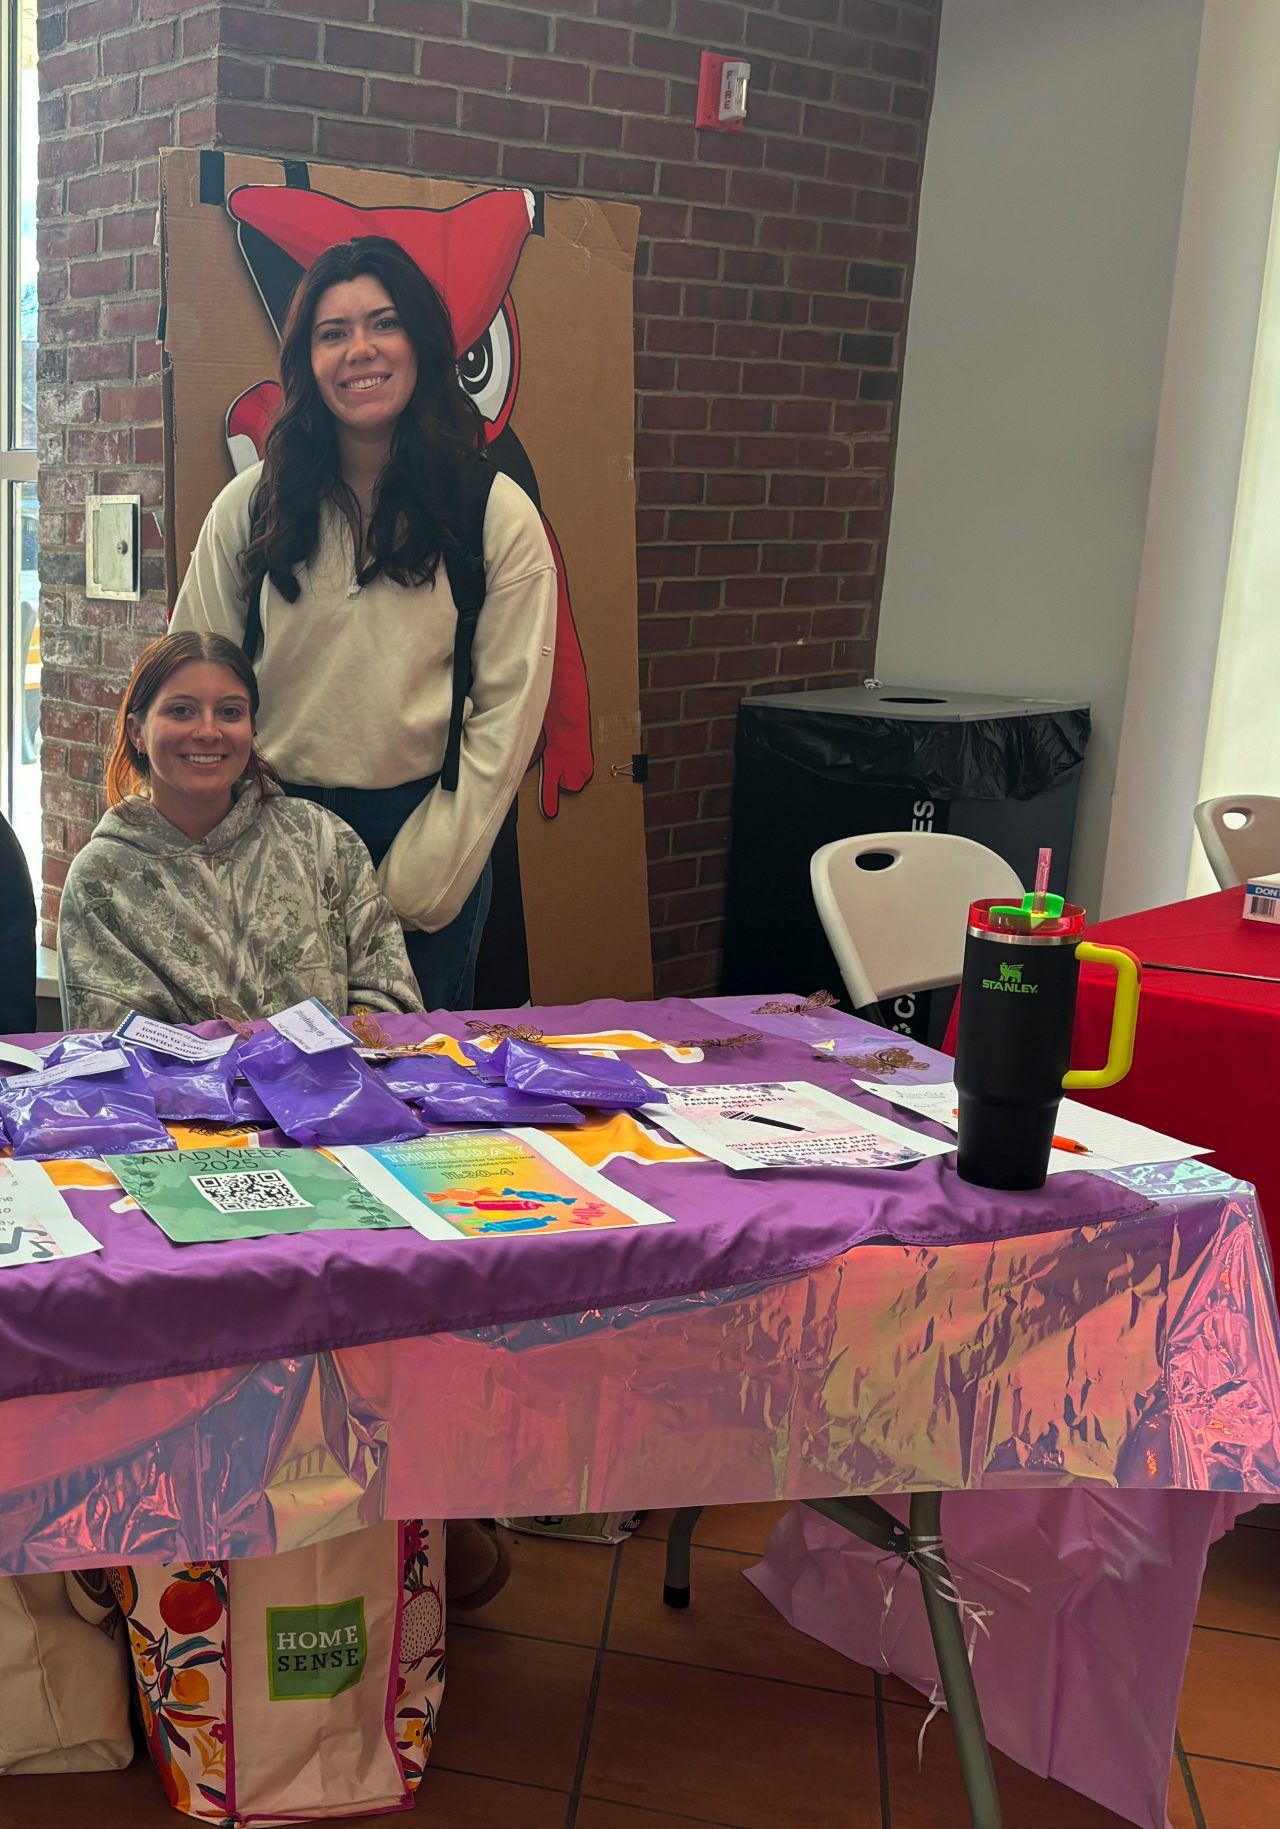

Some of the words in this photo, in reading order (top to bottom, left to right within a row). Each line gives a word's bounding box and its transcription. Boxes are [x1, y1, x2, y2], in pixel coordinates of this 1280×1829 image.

[724, 70, 735, 110] FIRE
[982, 979, 1038, 994] STANLEY
[135, 1031, 173, 1048] favorite
[141, 1026, 168, 1039] listen
[171, 1036, 181, 1044] to
[141, 1151, 211, 1165] ANAD
[215, 1149, 292, 1159] WEEK
[381, 1146, 524, 1163] THURSDAY
[194, 1159, 259, 1171] 2025
[276, 1625, 359, 1650] HOME
[277, 1648, 359, 1673] SENSE
